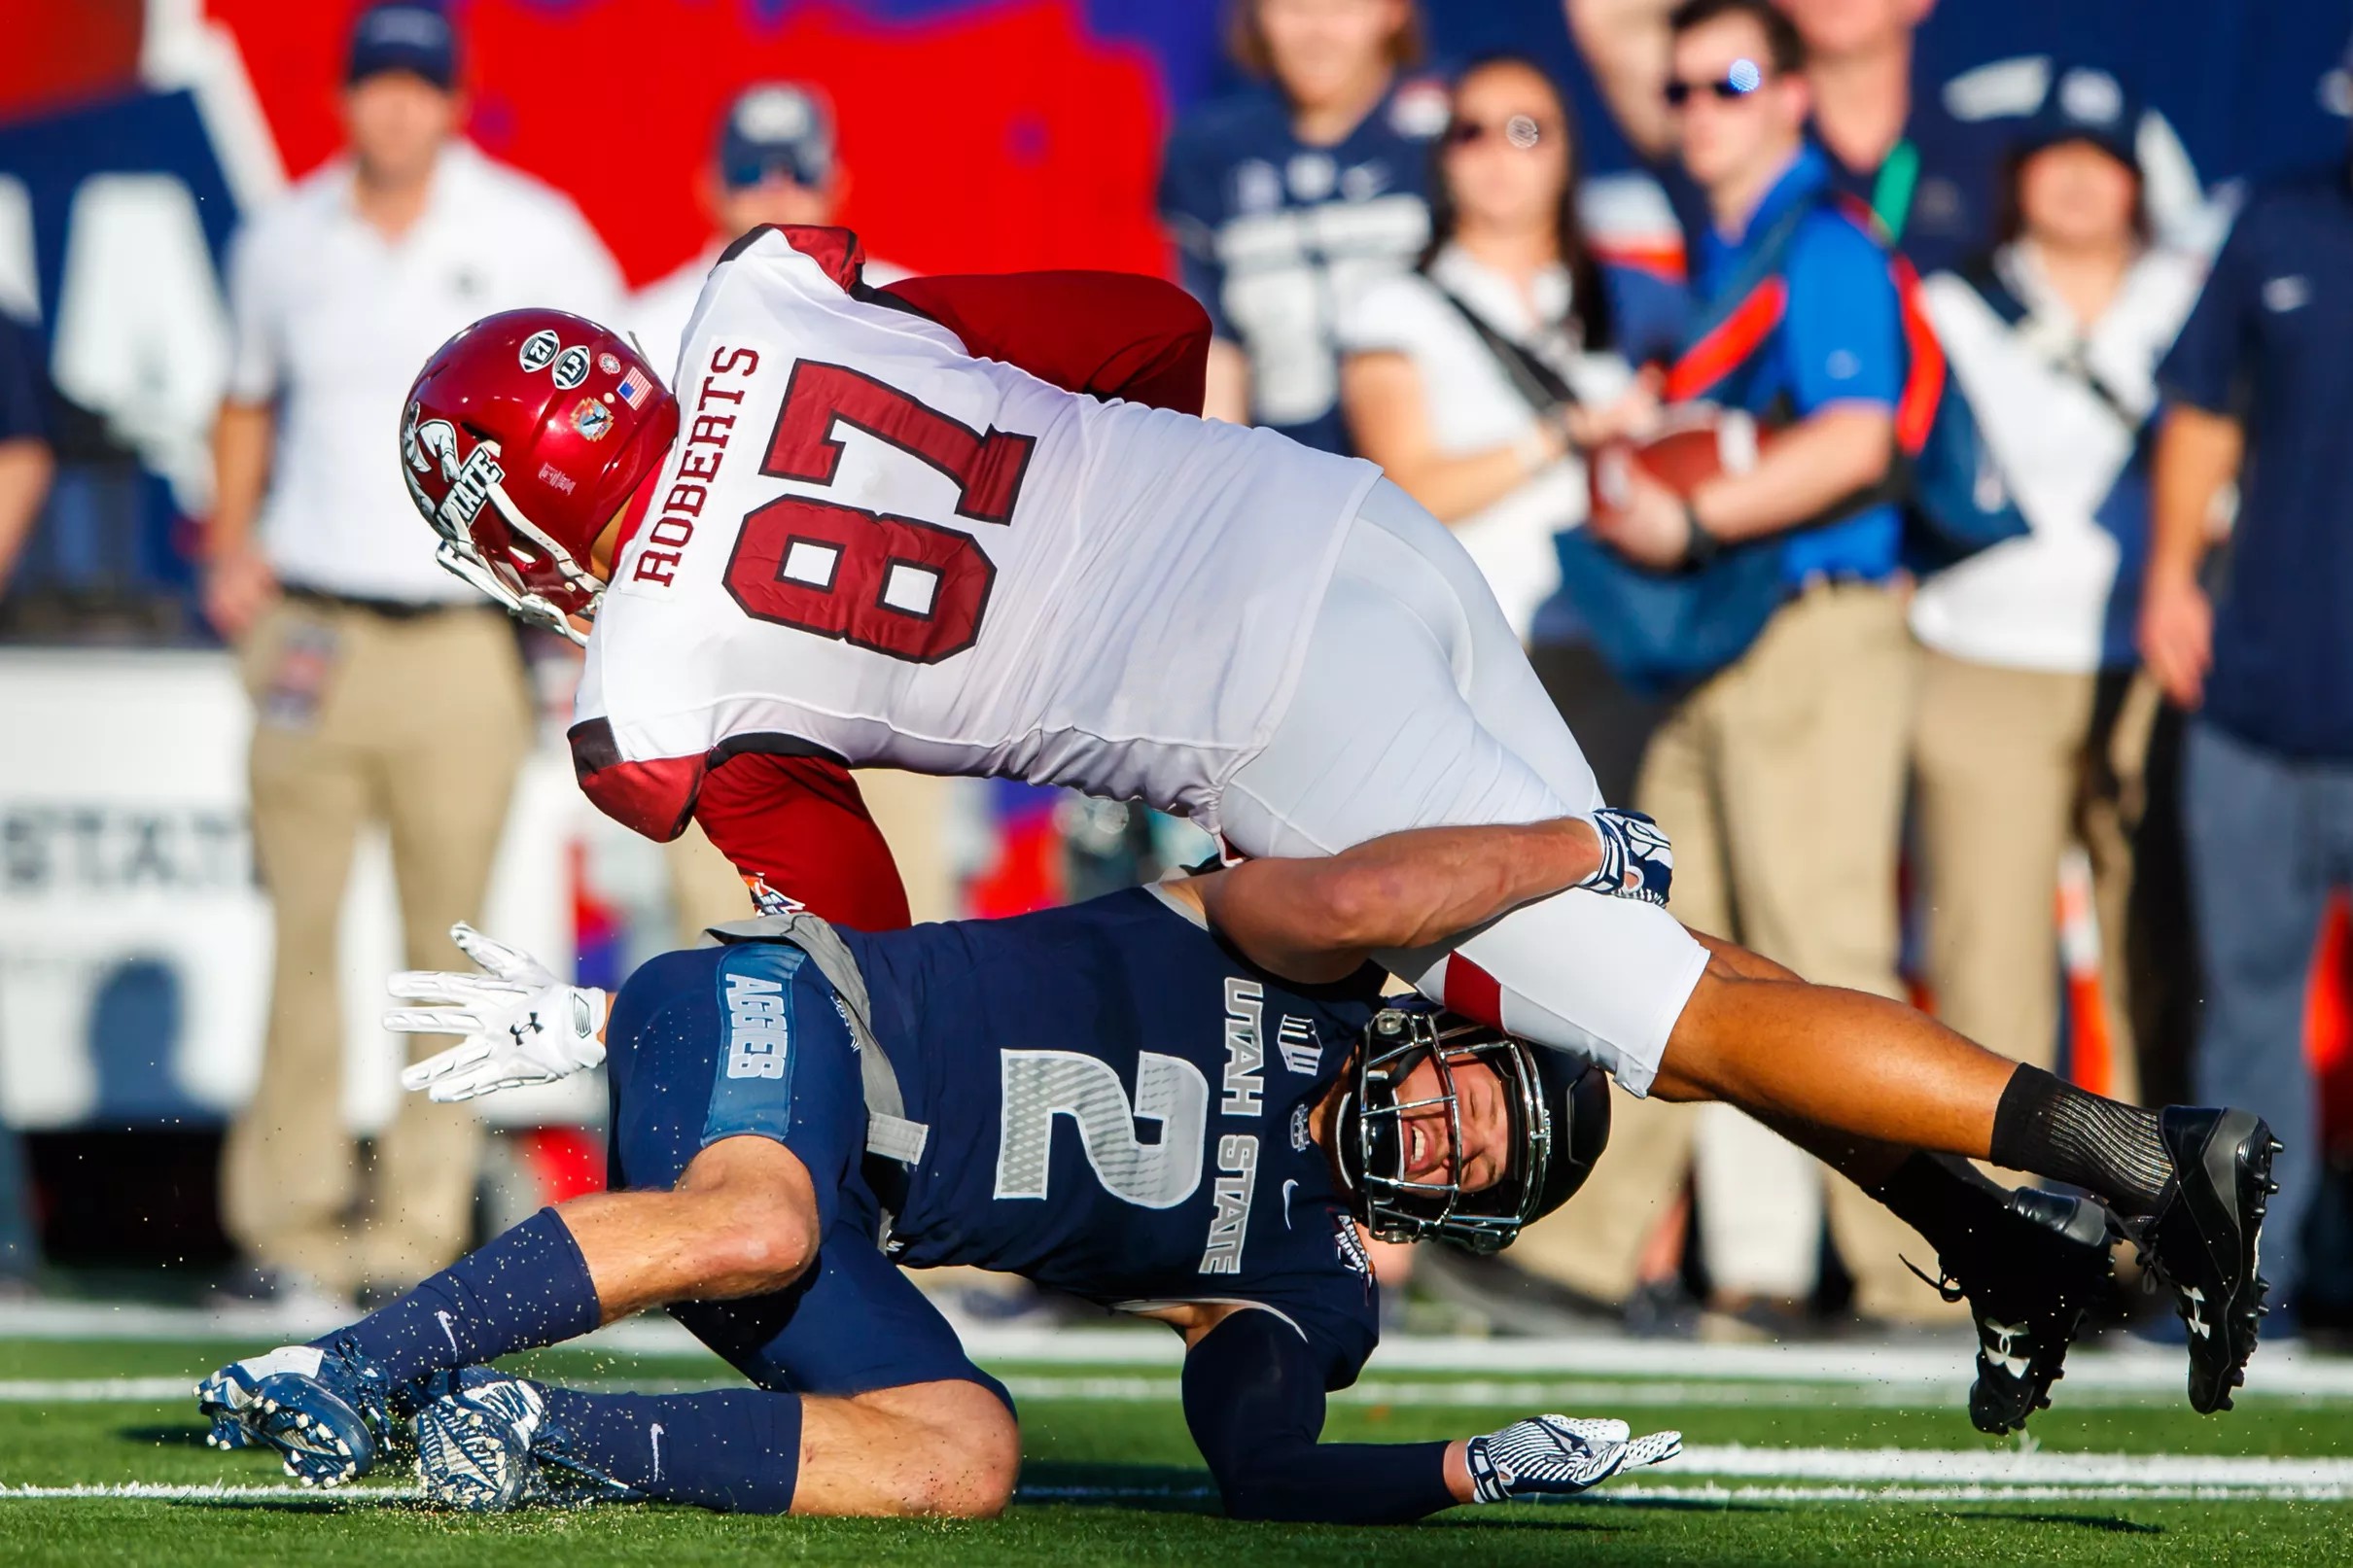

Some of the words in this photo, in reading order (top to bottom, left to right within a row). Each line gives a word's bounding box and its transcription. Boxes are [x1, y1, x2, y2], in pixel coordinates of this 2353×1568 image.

[529, 339, 552, 361] 27
[561, 354, 582, 380] LP
[439, 449, 502, 530] TATE
[633, 345, 759, 587] ROBERTS
[721, 357, 1037, 666] 87
[2, 810, 264, 889] STAT
[725, 973, 789, 1079] AGGIES
[1221, 976, 1264, 1117] UTAH
[993, 1048, 1210, 1210] 2
[1198, 1133, 1260, 1274] STATE
